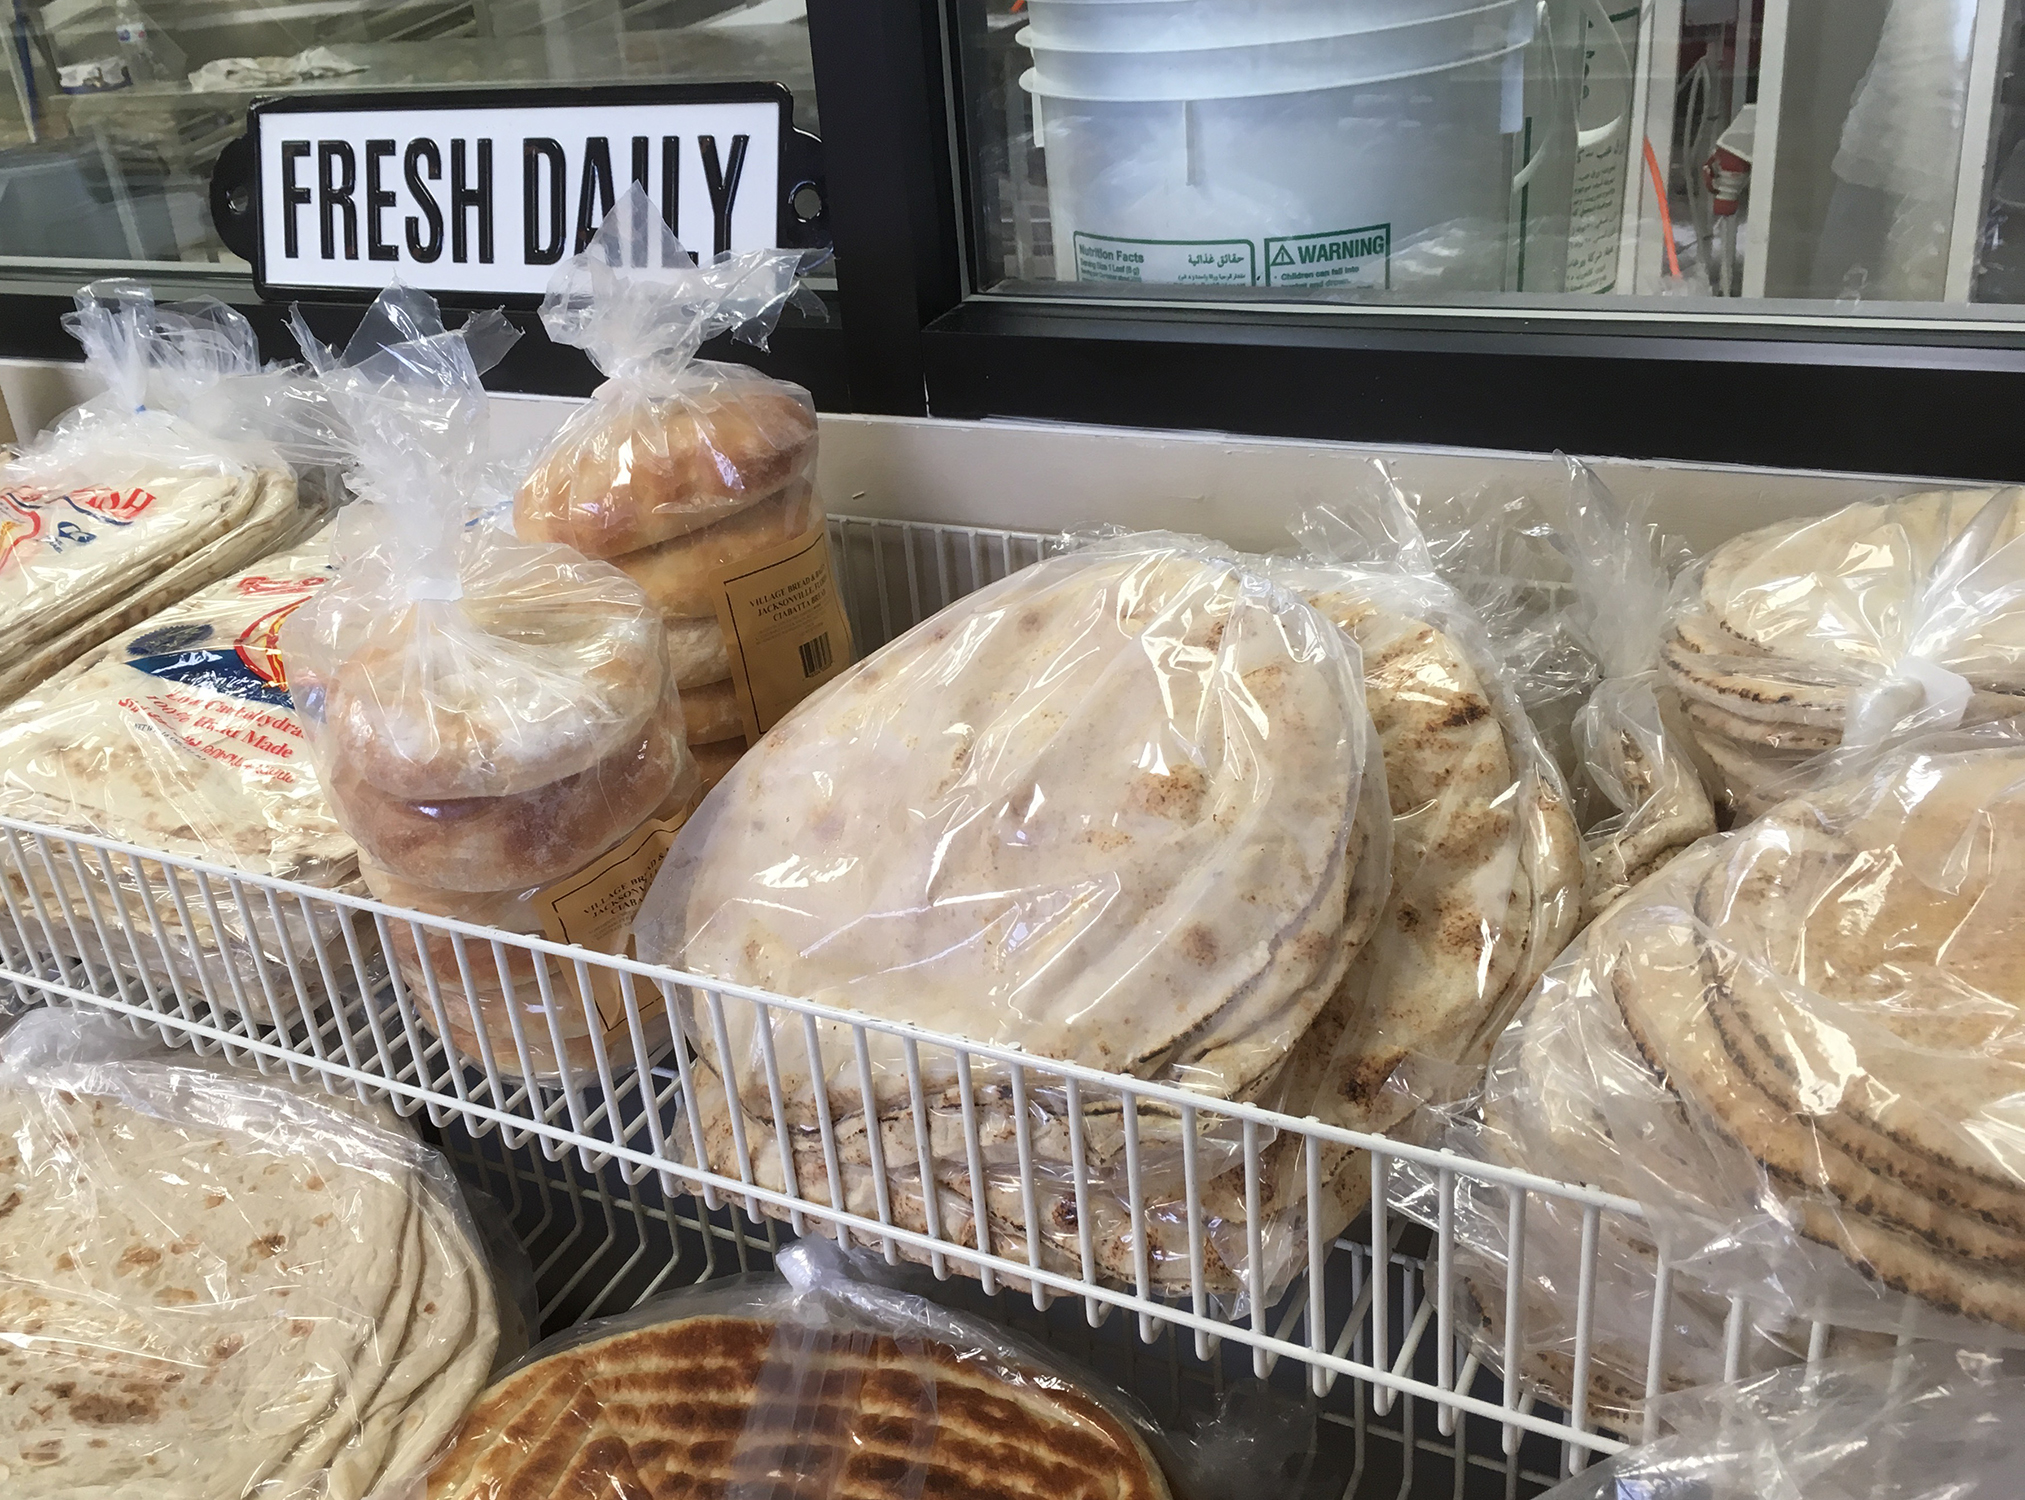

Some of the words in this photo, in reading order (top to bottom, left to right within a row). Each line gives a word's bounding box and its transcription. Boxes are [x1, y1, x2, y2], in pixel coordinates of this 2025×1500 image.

[280, 136, 495, 264] FRESH
[522, 133, 751, 268] DAILY
[1079, 244, 1114, 260] Nutrition
[1116, 250, 1144, 263] Facts
[1217, 253, 1244, 268] حقائق
[1297, 235, 1385, 264] WARNING
[1281, 270, 1315, 281] Children
[1315, 269, 1330, 278] can
[749, 588, 785, 607] VILLAGE
[787, 577, 812, 593] BREAD
[773, 600, 811, 621] CIABATTA
[241, 729, 294, 758] Made
[583, 883, 628, 914] VILLAGE
